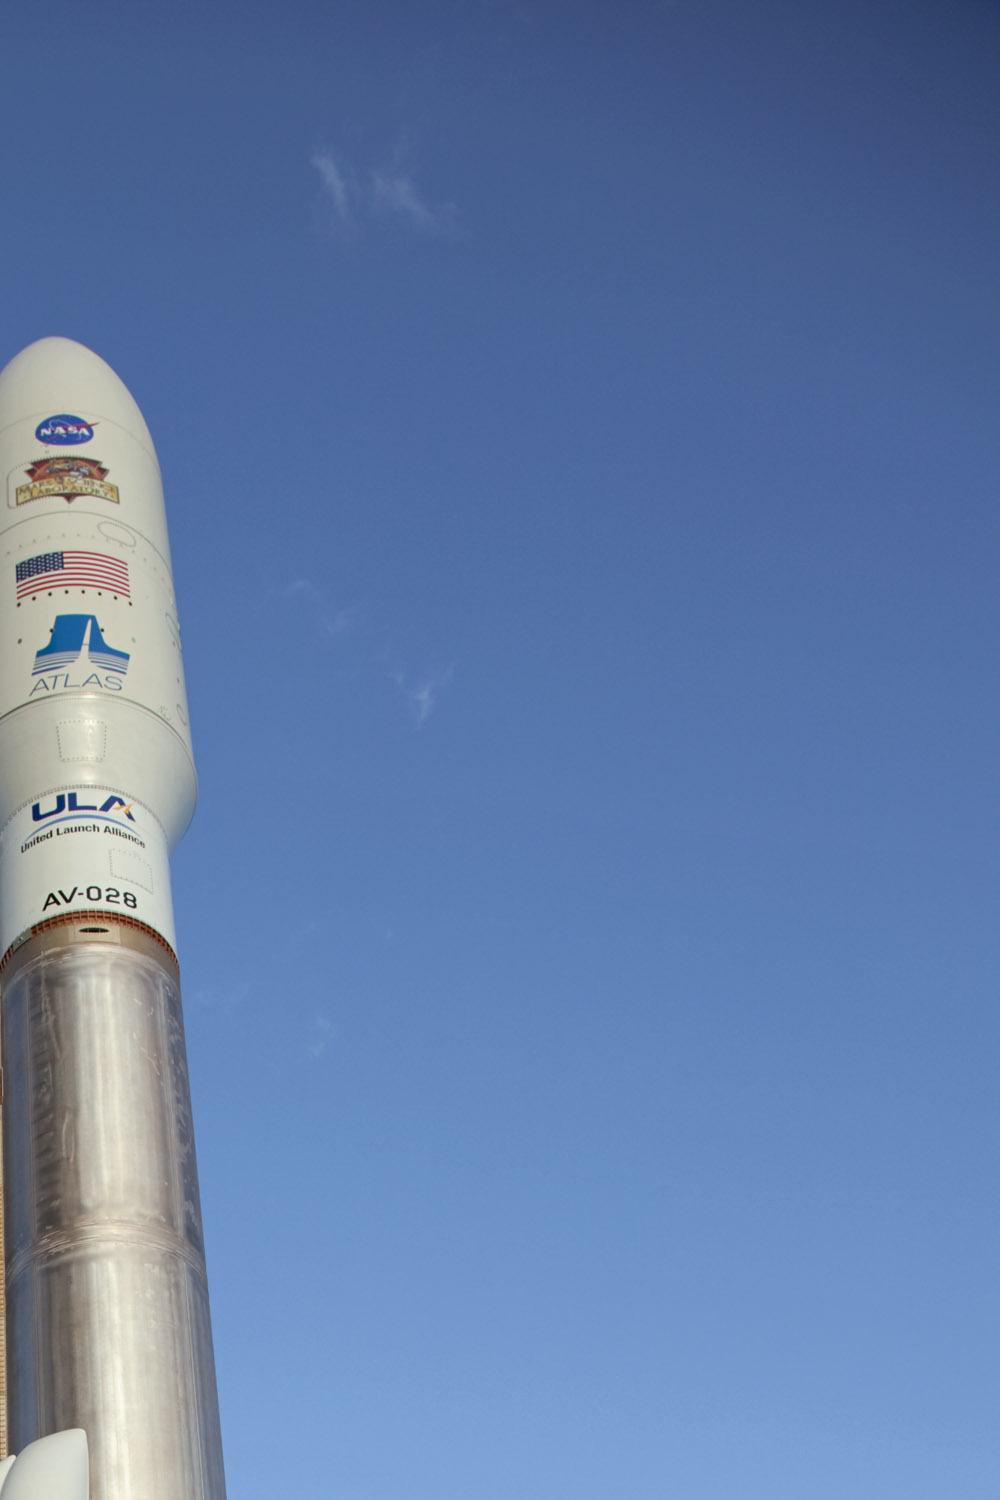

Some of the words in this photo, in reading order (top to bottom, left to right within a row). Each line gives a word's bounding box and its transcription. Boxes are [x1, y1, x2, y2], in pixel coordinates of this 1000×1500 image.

[40, 426, 90, 438] NASA
[29, 673, 123, 696] ATLAS
[31, 792, 136, 822] ULA
[20, 830, 53, 854] United
[56, 824, 100, 836] Launch
[103, 825, 146, 849] Alliance
[42, 886, 137, 911] AV-028
